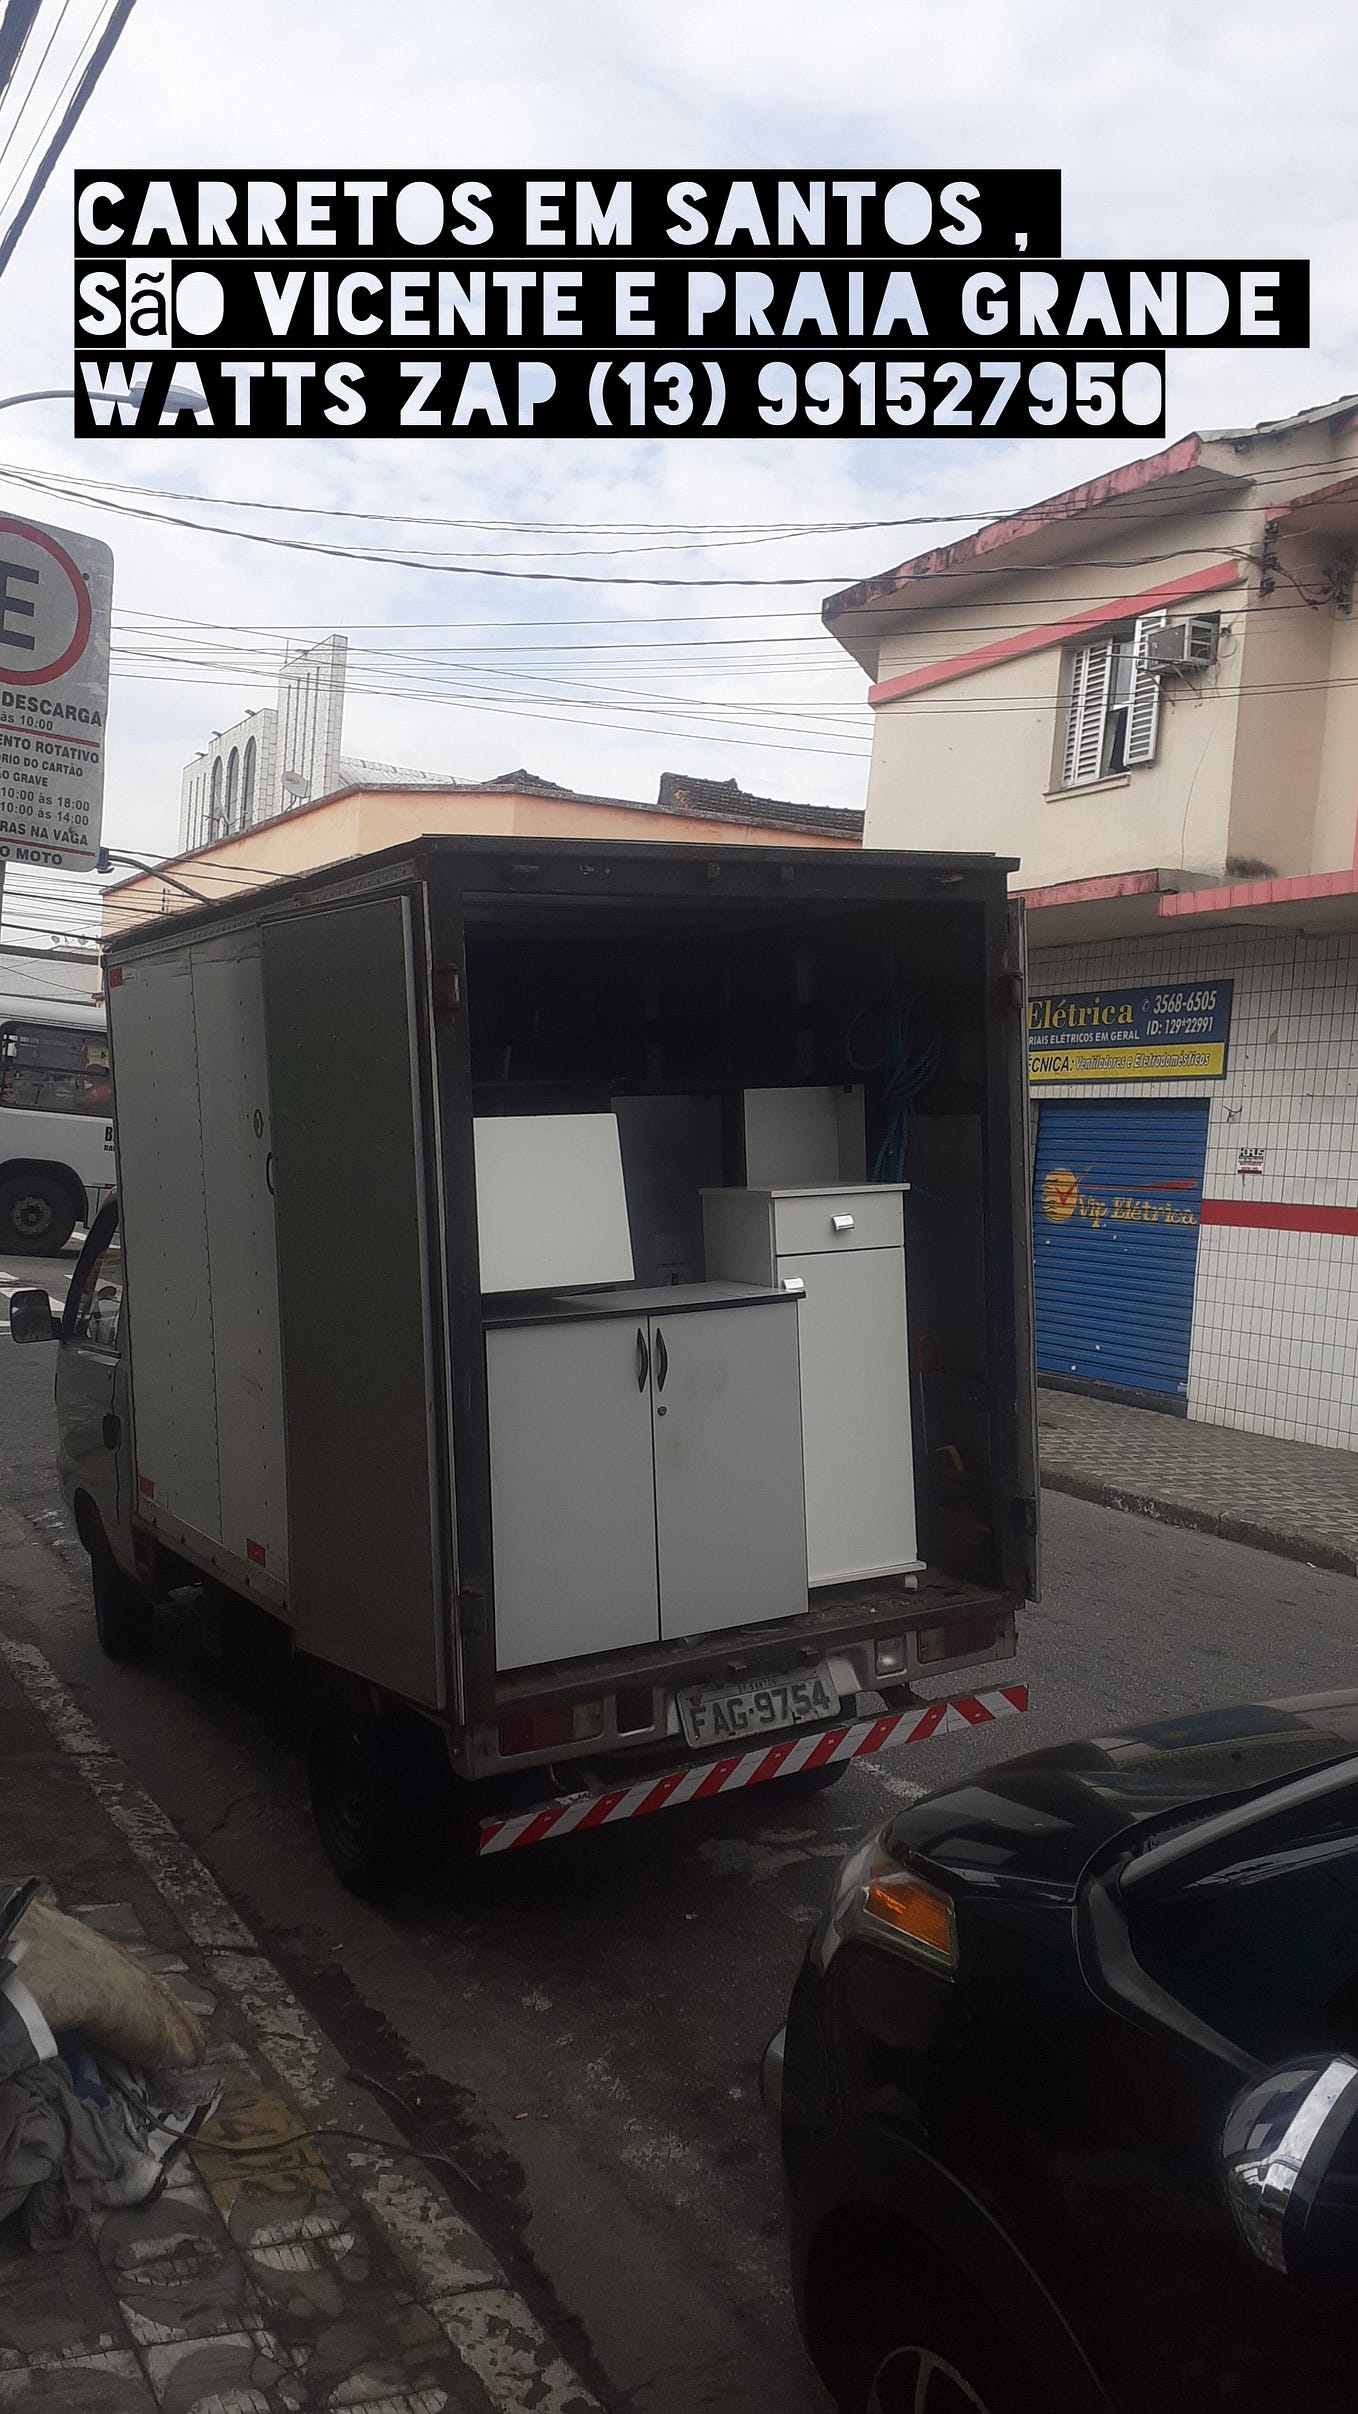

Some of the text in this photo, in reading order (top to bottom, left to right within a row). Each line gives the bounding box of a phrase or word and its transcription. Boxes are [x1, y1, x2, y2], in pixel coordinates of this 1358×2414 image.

[1, 690, 102, 727] DESCARGA
[20, 714, 53, 731] 10:00
[35, 740, 100, 764] ROTATIVO
[0, 753, 83, 777] RIO DO CARTÃO
[13, 772, 49, 787] GRAVE
[1, 786, 90, 812] 10:00 às 18:00
[0, 801, 89, 826] 10:00 às 14:00
[30, 825, 49, 840] NA
[53, 828, 88, 846] VAGA
[16, 847, 63, 866] MOTO
[1028, 997, 1134, 1030] Elétrica
[1153, 989, 1218, 1015] 3568-6505
[1050, 1031, 1094, 1045] ELÉTRICOS
[1095, 1031, 1109, 1042] EM
[1110, 1029, 1140, 1041] GERAL
[1146, 1020, 1163, 1036] ID:
[1076, 1194, 1198, 1229] Vip Elétrica
